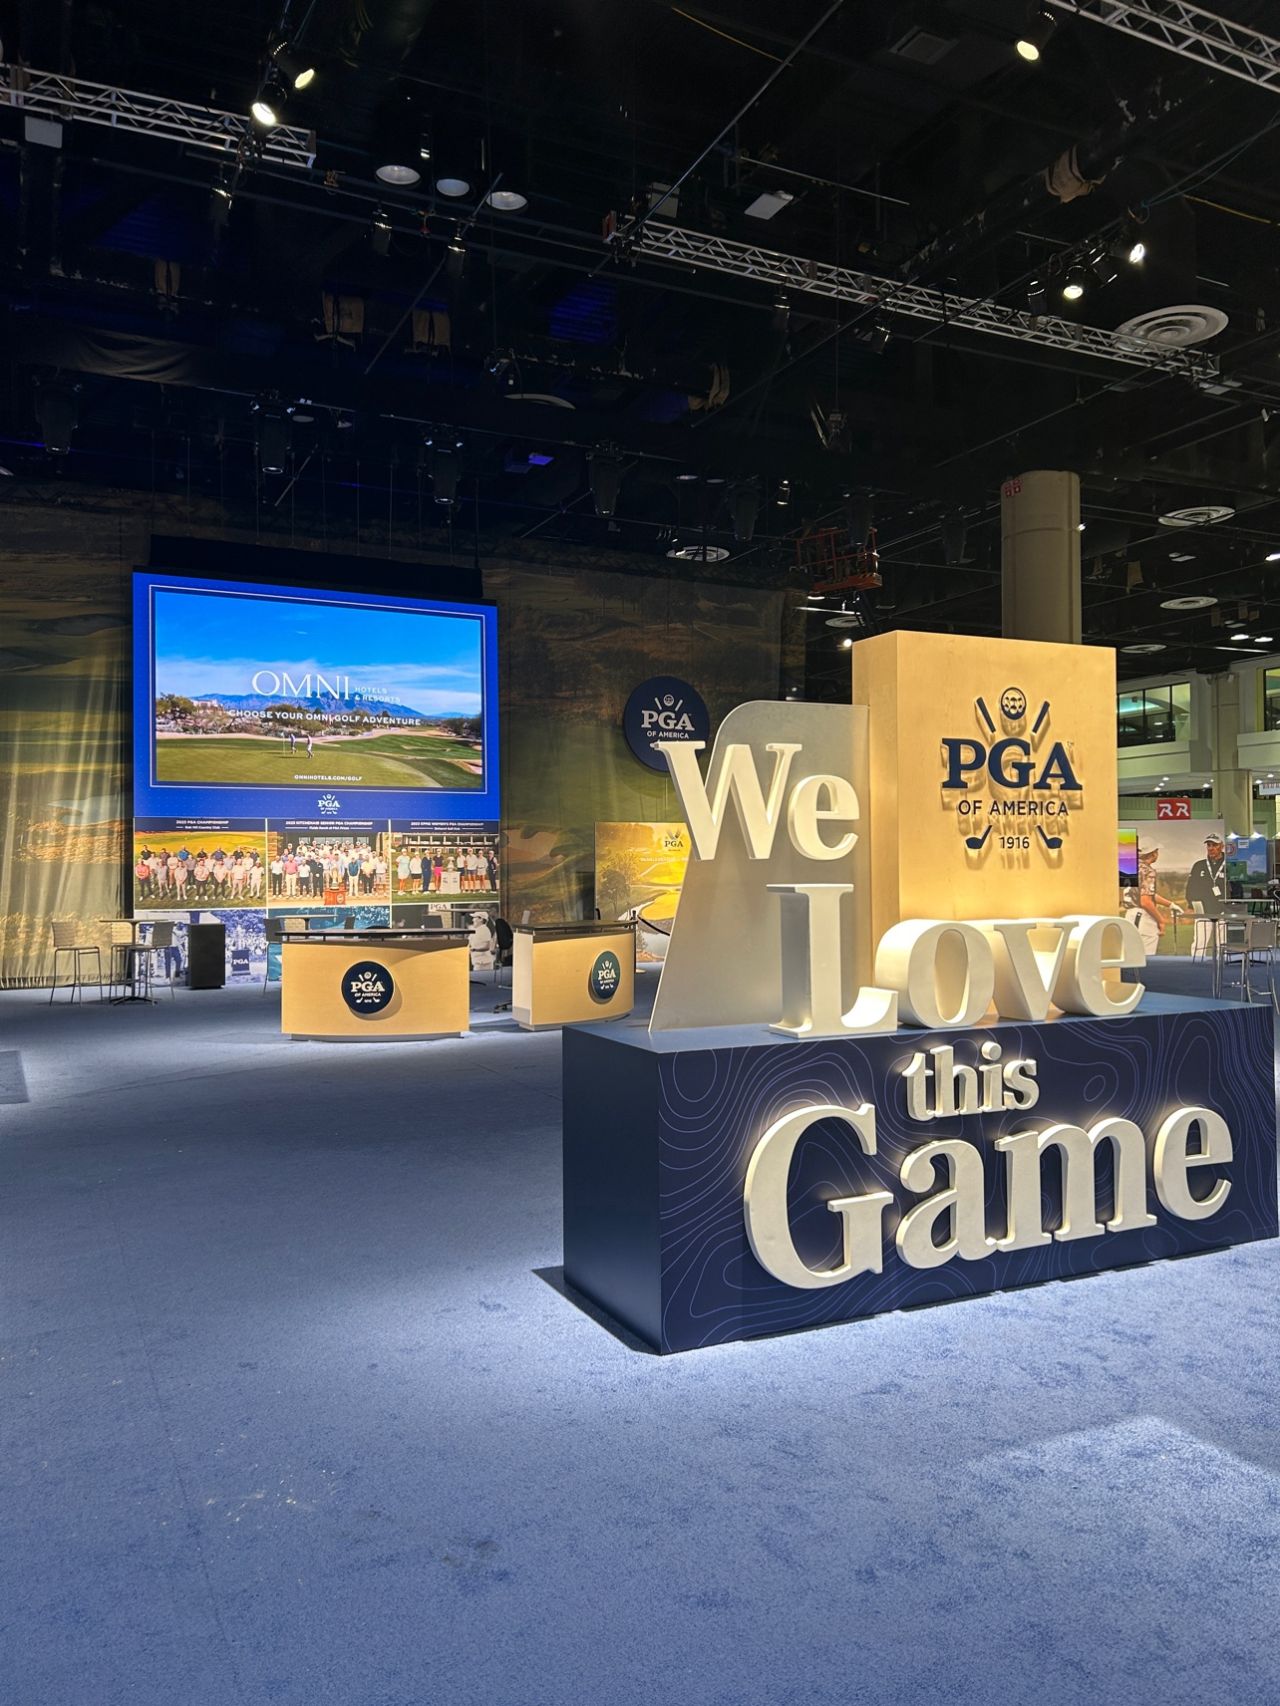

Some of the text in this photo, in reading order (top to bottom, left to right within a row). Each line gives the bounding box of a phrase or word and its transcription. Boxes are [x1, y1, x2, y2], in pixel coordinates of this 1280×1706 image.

[252, 670, 350, 700] OMNI
[229, 709, 421, 726] CHOOSE YOUR OMNI GOLF ADVENTURE
[641, 709, 695, 731] PGA
[941, 737, 1083, 791] PGA
[317, 799, 340, 808] PGA
[650, 740, 860, 861] We
[958, 800, 1069, 816] OF AMERICA
[664, 840, 684, 848] PGA
[999, 837, 1030, 849] 1916
[767, 882, 1147, 1039] Love
[597, 968, 616, 980] PGA
[350, 981, 385, 993] PGA
[902, 1041, 1040, 1122] this
[744, 1103, 1234, 1290] Game
